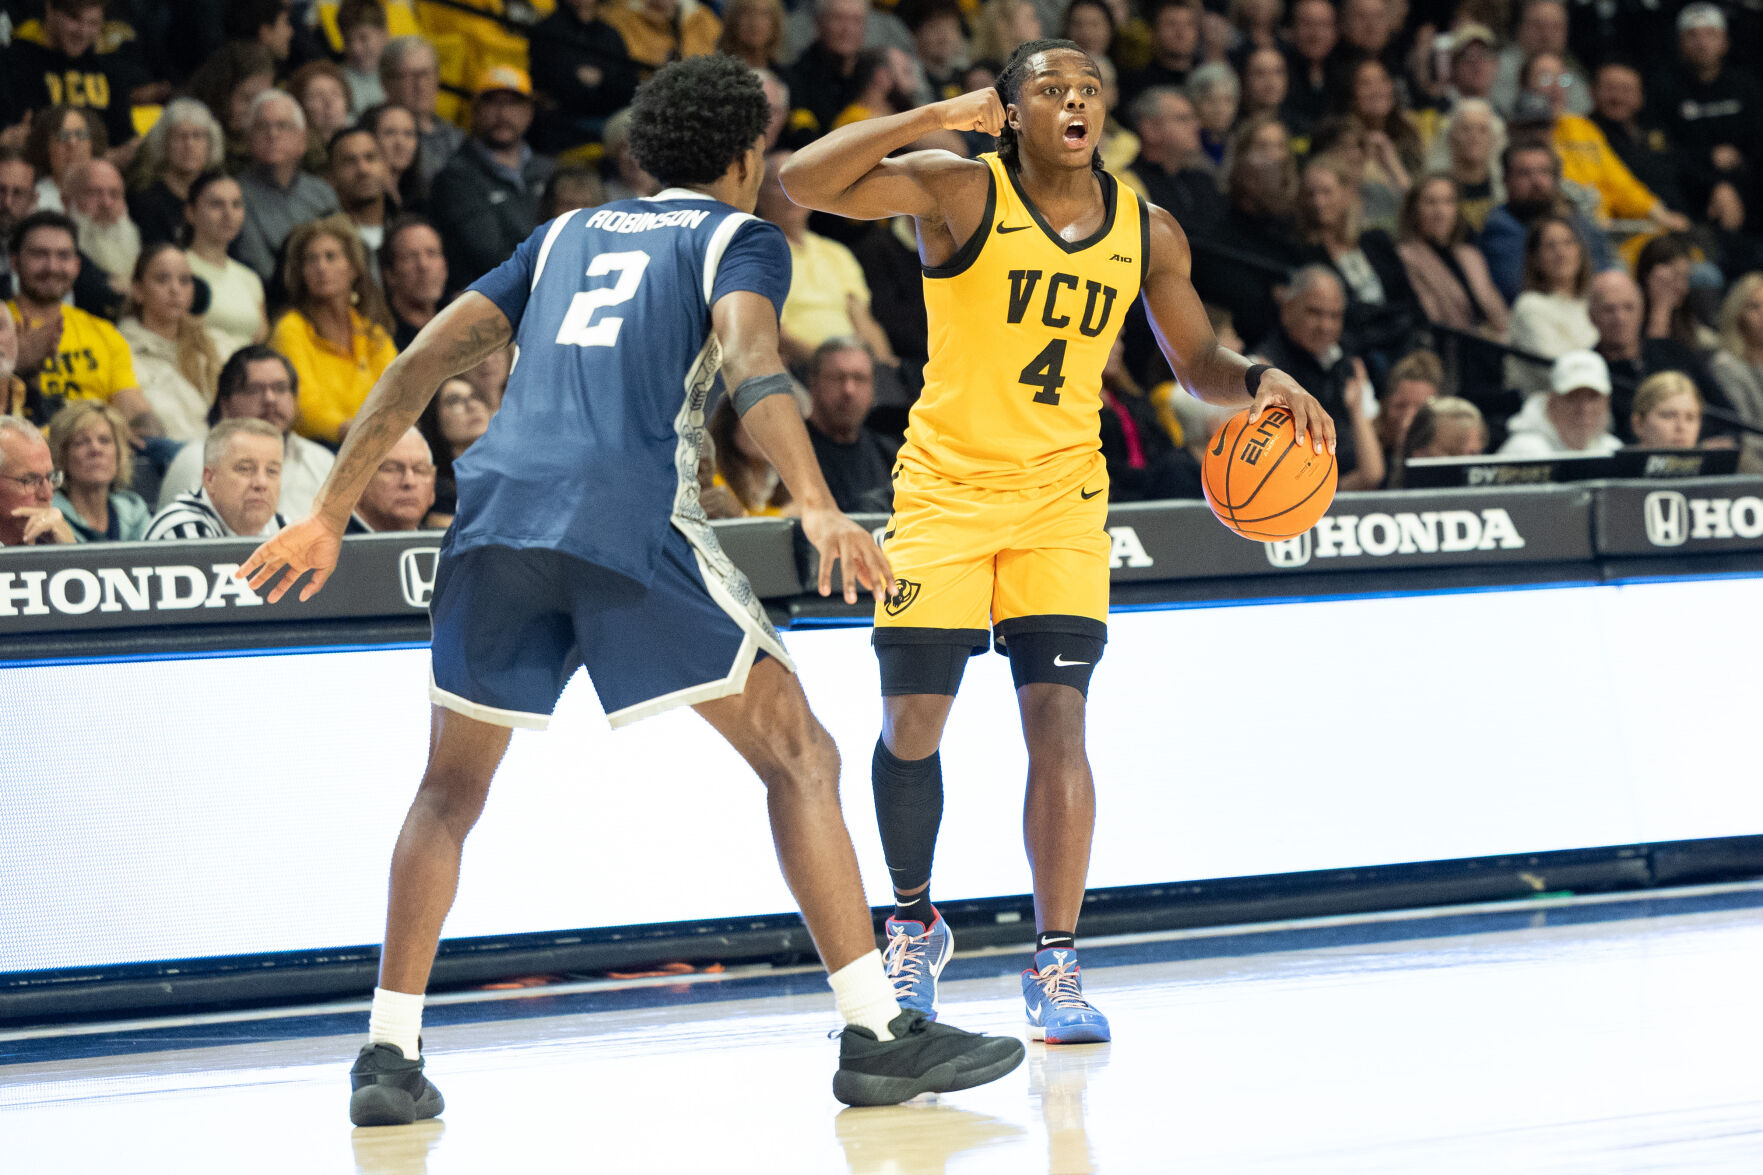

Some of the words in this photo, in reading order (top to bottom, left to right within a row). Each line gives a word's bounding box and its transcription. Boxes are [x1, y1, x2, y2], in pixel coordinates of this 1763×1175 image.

[585, 209, 711, 234] ROBINSON
[556, 250, 650, 347] 2
[1007, 269, 1118, 338] VCU
[1018, 338, 1068, 406] 4
[1240, 410, 1292, 467] ELITE
[1315, 508, 1526, 558] HONDA
[0, 563, 264, 616] HONDA
